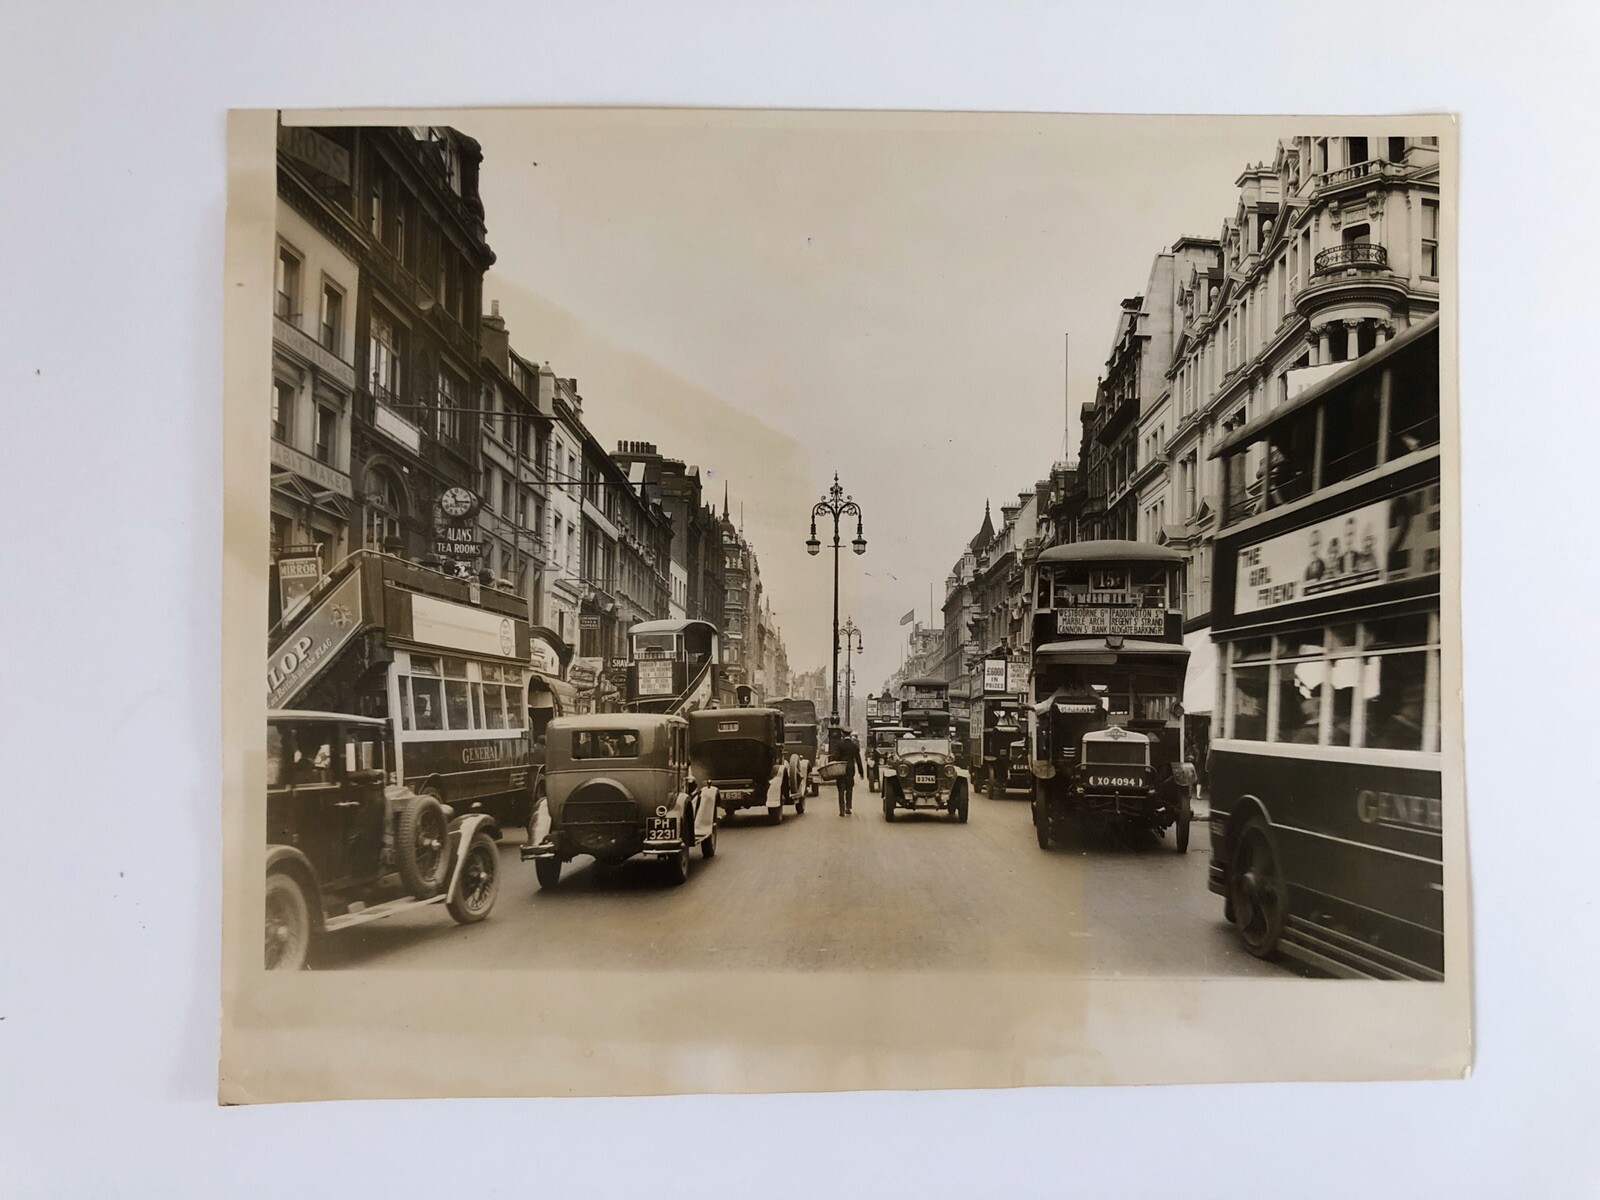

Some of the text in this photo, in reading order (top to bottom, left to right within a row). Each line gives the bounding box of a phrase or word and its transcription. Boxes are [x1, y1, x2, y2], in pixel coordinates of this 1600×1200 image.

[447, 527, 472, 542] ALANS
[437, 542, 481, 555] TEA ROOMS
[1241, 546, 1261, 568] THE
[280, 563, 317, 576] MIRROR
[1111, 609, 1151, 618] PADDINGTON
[1062, 617, 1105, 625] MARBLE ARCH
[1111, 617, 1133, 626] REGENT
[1141, 617, 1163, 626] STRAND
[1059, 625, 1082, 633] CANNON
[1092, 625, 1108, 633] BANK
[314, 637, 332, 660] FLAG
[462, 746, 500, 764] GENERAL
[1111, 777, 1136, 787] 4094
[654, 818, 670, 829] PH
[649, 829, 676, 840] 3231
